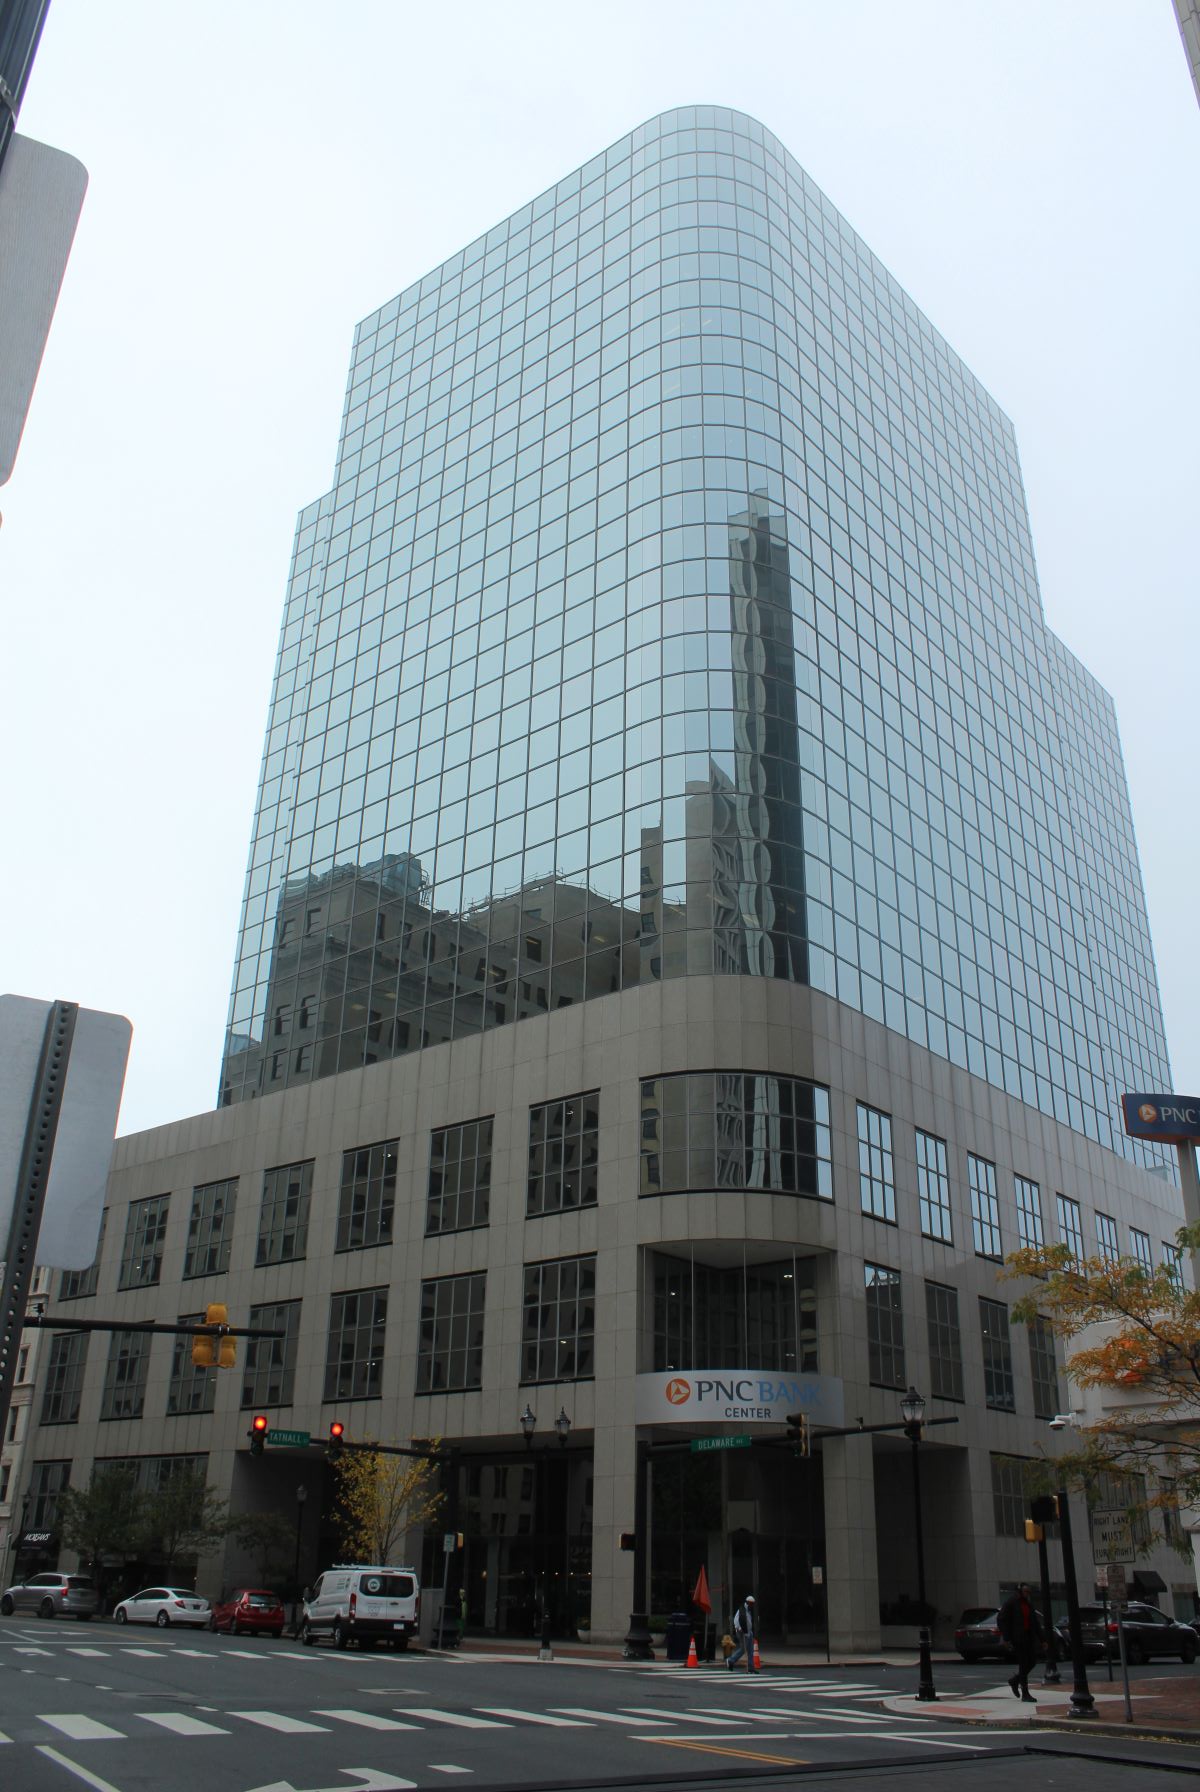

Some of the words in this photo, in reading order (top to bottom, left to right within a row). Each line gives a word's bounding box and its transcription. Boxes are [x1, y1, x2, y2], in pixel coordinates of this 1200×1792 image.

[1160, 1106, 1197, 1124] PNC
[695, 1380, 753, 1402] PNC
[756, 1380, 823, 1404] BANK
[725, 1407, 771, 1419] CENTER
[269, 1431, 301, 1444] TATNALL
[698, 1437, 735, 1450] DELAWARE
[1102, 1531, 1122, 1542] MUST
